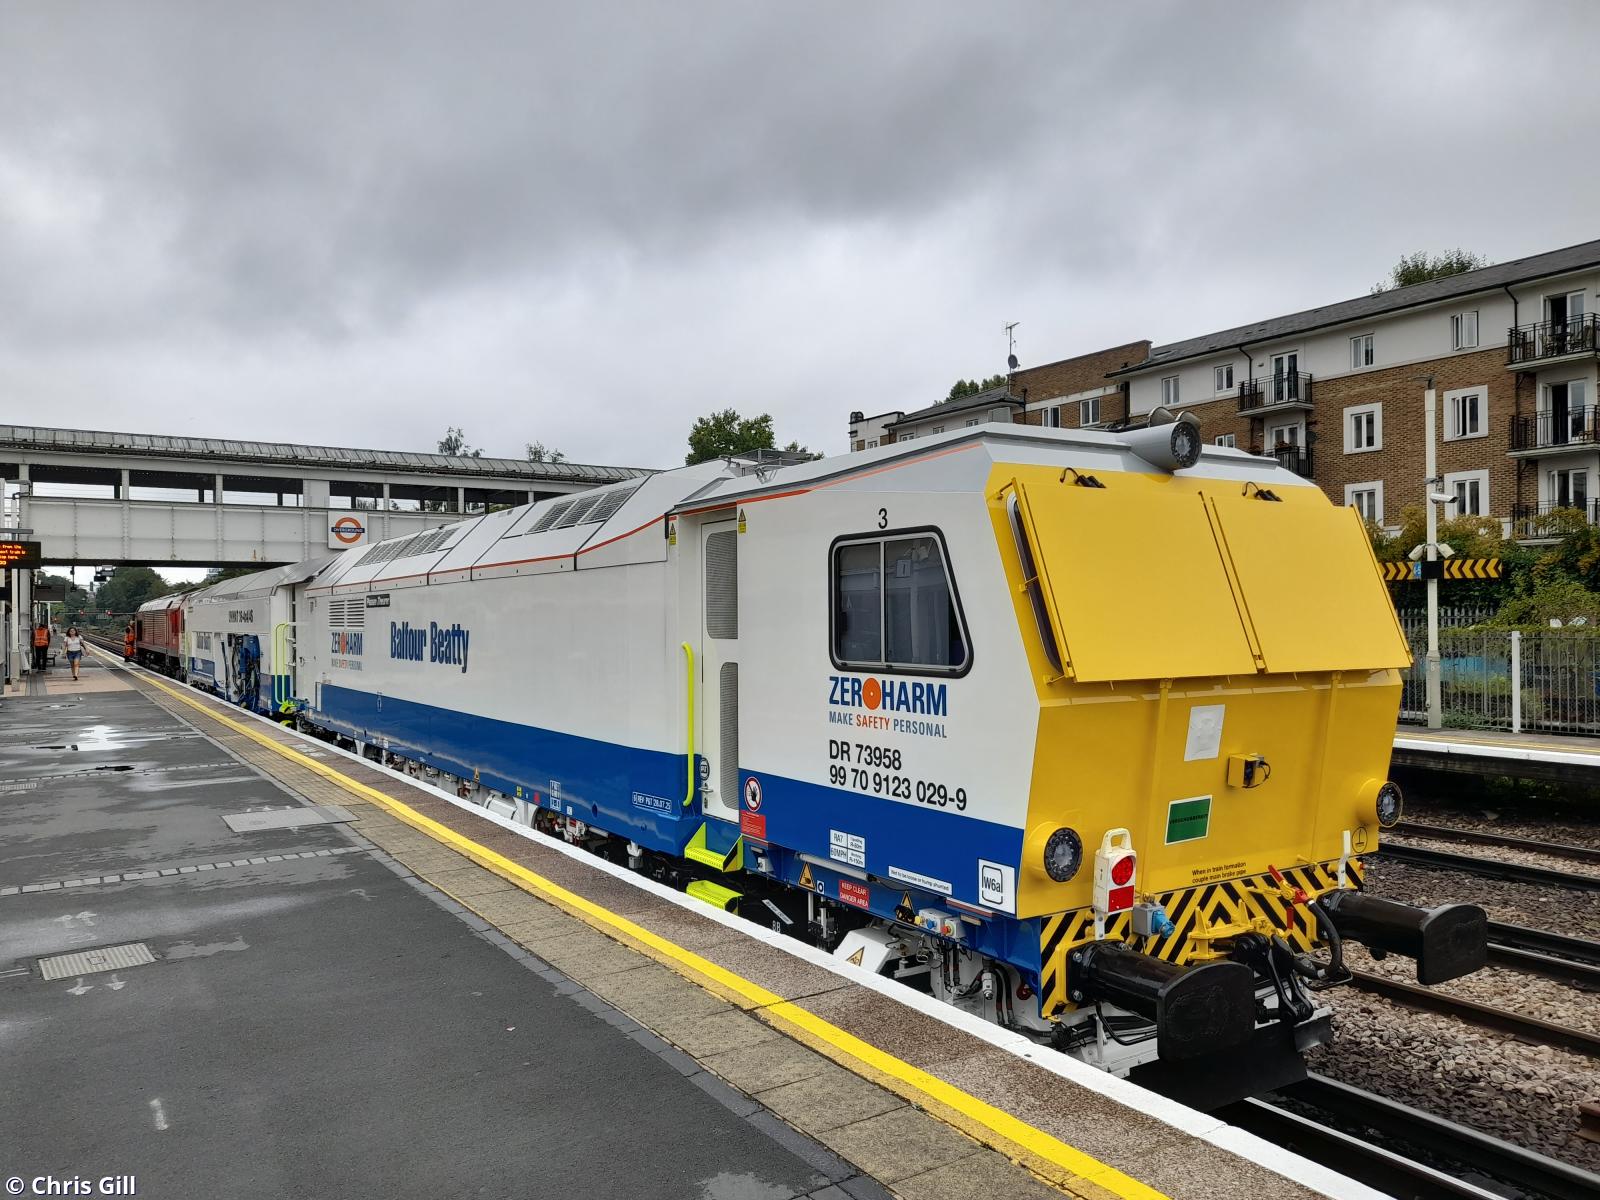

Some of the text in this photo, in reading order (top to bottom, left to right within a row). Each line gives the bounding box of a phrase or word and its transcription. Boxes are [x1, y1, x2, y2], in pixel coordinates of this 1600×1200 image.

[878, 507, 888, 529] 3
[390, 621, 469, 674] Balfour Beatty
[829, 711, 948, 739] MAKE SAFETY PERSONAL
[829, 739, 902, 771] DR 73958
[829, 764, 967, 811] 99 70 9123 029-9
[833, 832, 844, 843] RA7
[1224, 862, 1246, 870] formation
[983, 876, 1001, 893] W6a
[1192, 876, 1208, 884] couple
[1222, 870, 1235, 878] brake
[1236, 869, 1247, 877] pipe
[841, 882, 867, 896] KEEP CLEAR
[840, 892, 868, 907] DANGER AREA
